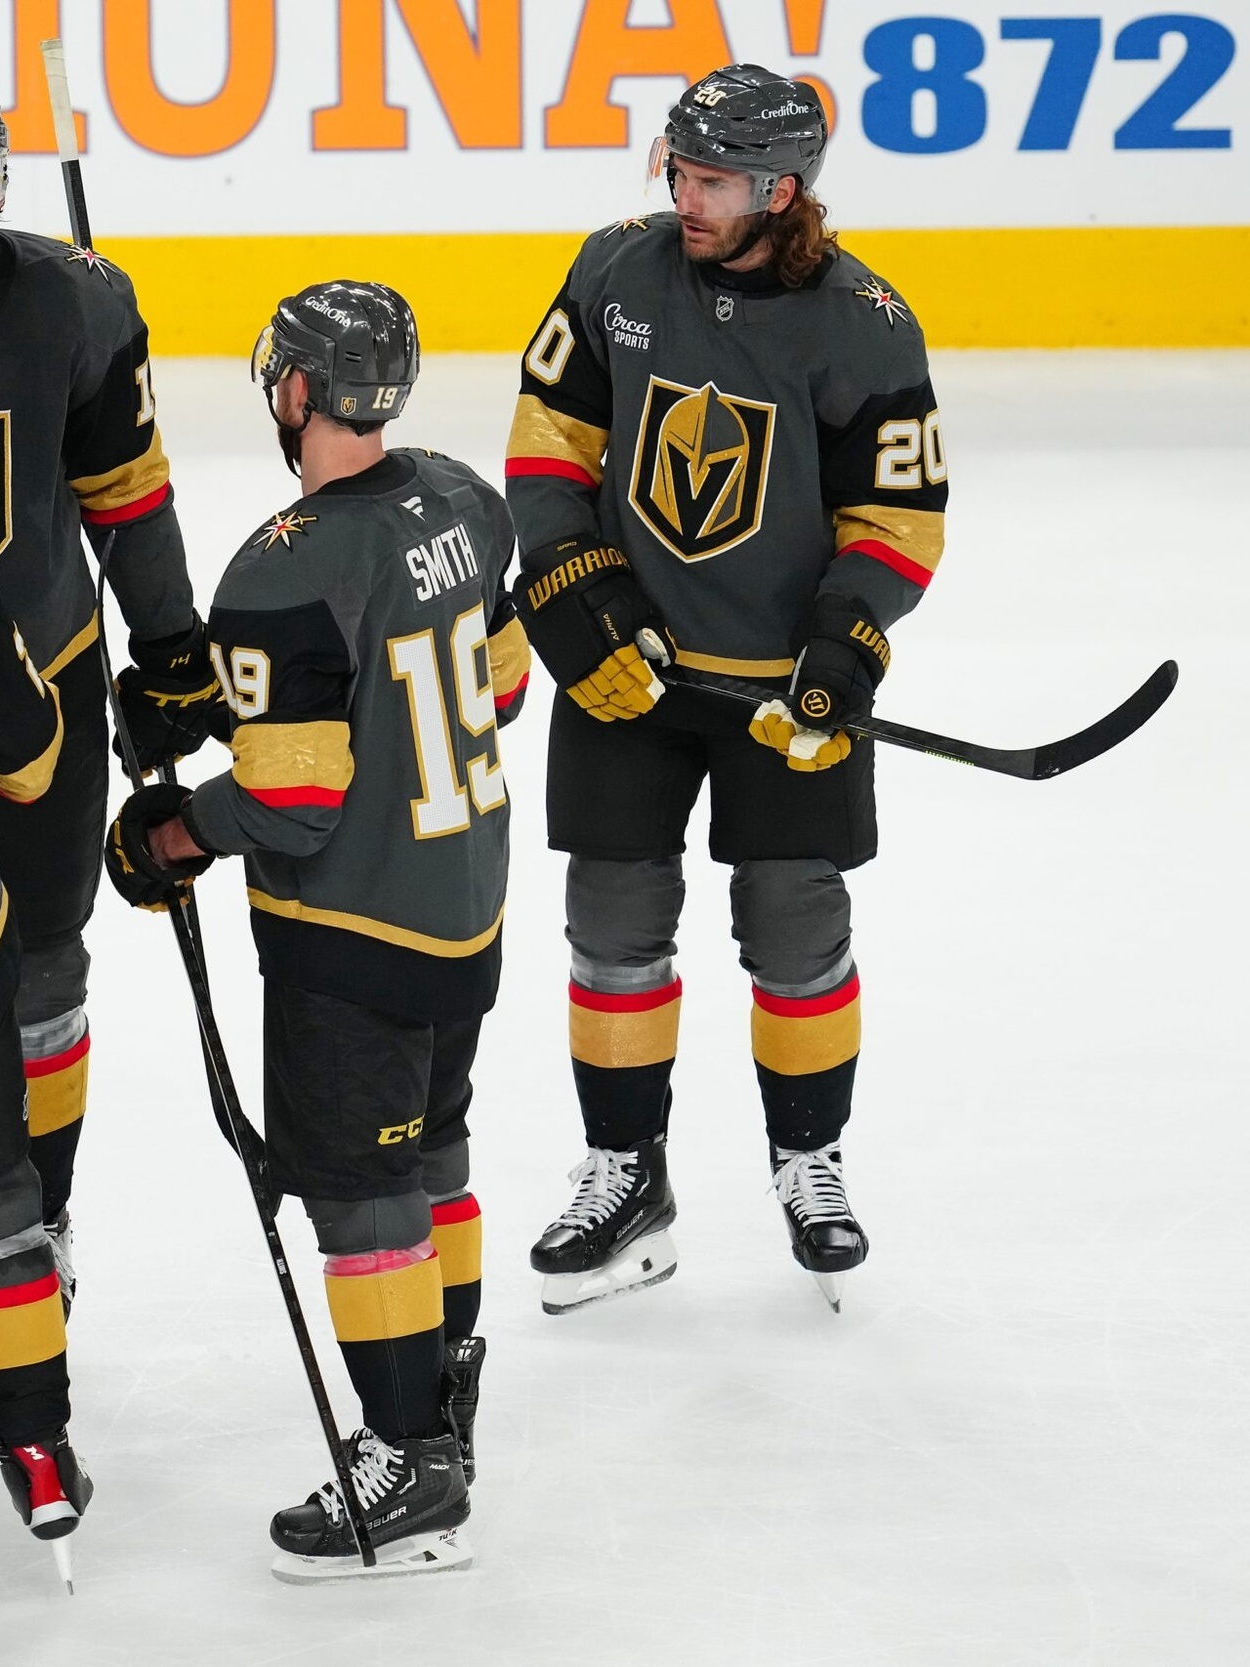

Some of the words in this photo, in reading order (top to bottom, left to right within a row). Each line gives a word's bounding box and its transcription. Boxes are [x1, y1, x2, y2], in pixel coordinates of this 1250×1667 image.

[694, 86, 727, 108] 20
[861, 13, 1236, 157] 872
[760, 104, 810, 121] CreditOne
[305, 296, 351, 328] CreditOne
[604, 302, 653, 335] Circa
[525, 308, 576, 387] 0
[614, 330, 650, 350] SPORTS
[135, 360, 155, 427] 1
[372, 387, 398, 409] 19
[874, 407, 947, 490] 20
[405, 522, 481, 602] SMITH
[169, 653, 190, 669] 14
[209, 641, 271, 720] 19
[387, 600, 507, 840] 19
[377, 1113, 426, 1146] CC
